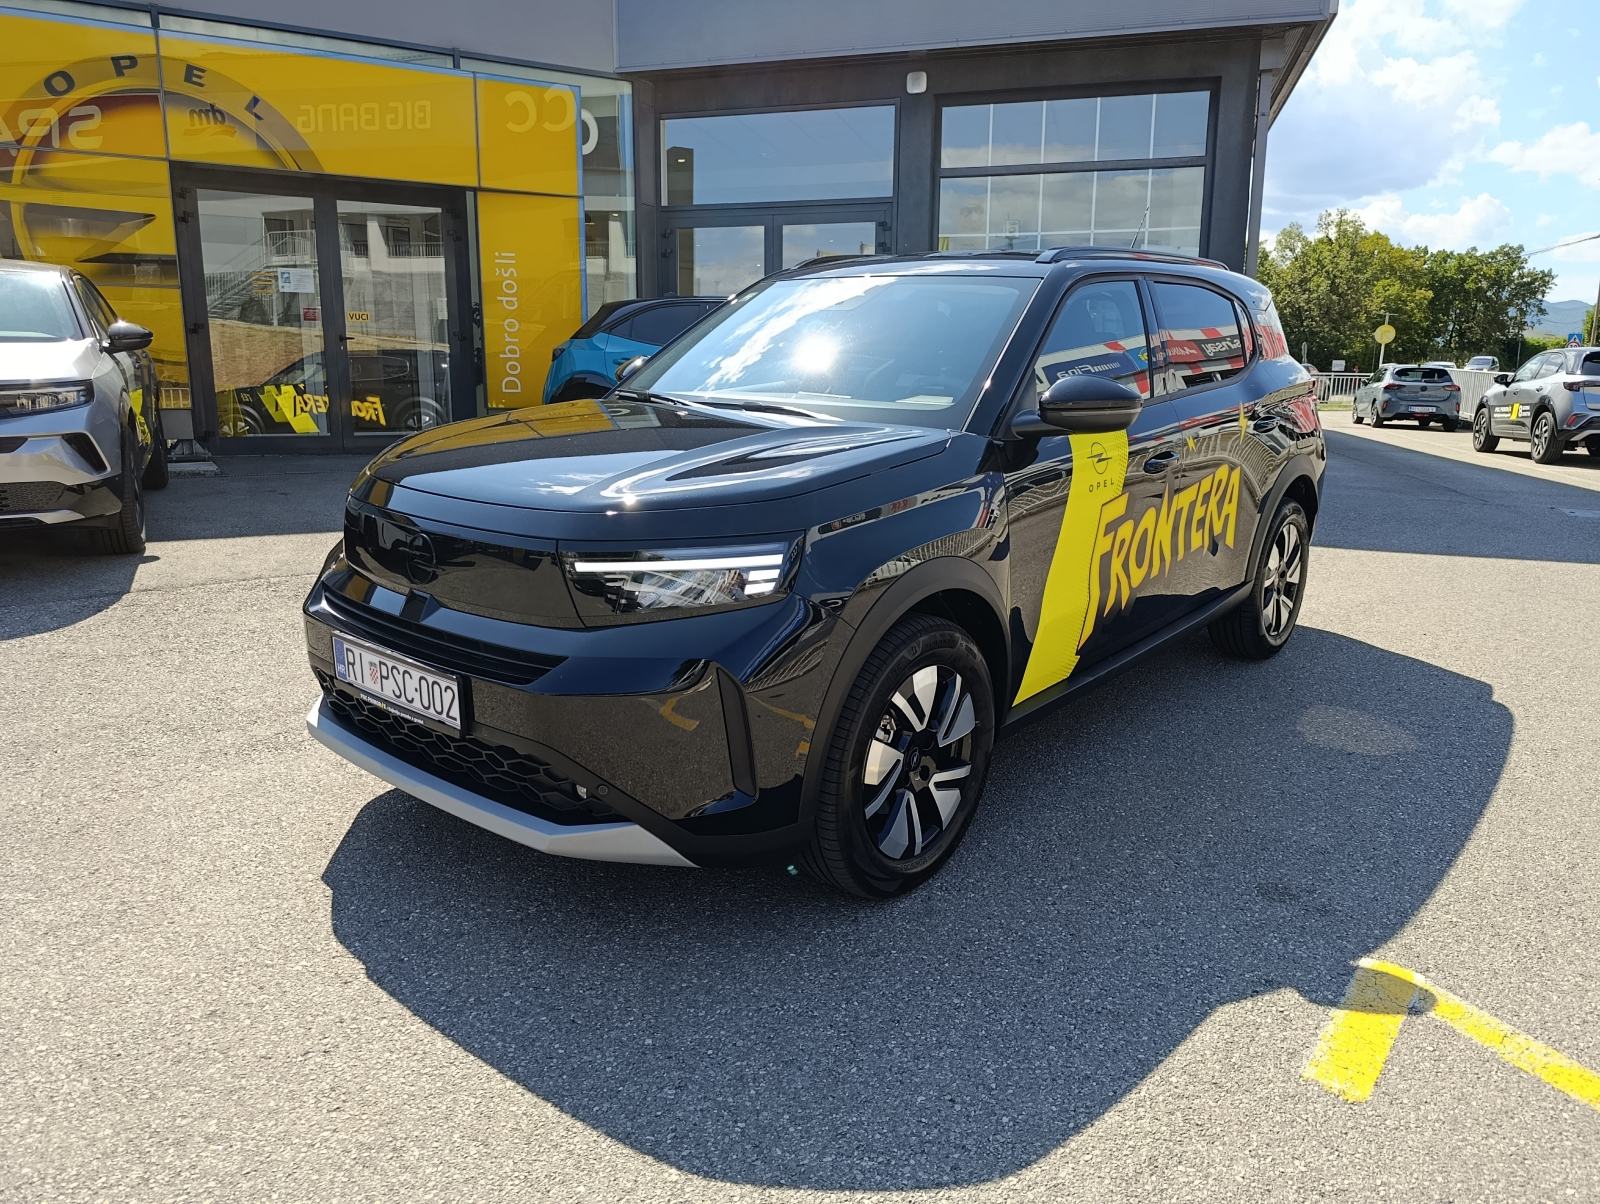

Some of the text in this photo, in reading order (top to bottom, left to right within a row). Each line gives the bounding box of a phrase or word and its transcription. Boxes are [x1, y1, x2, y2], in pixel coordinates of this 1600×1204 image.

[43, 55, 264, 121] OPEL
[348, 312, 370, 322] VUCI
[494, 252, 522, 394] Dobro došli
[1088, 478, 1115, 493] OPEL
[1078, 463, 1242, 650] FRONTERA
[345, 647, 365, 684] RI
